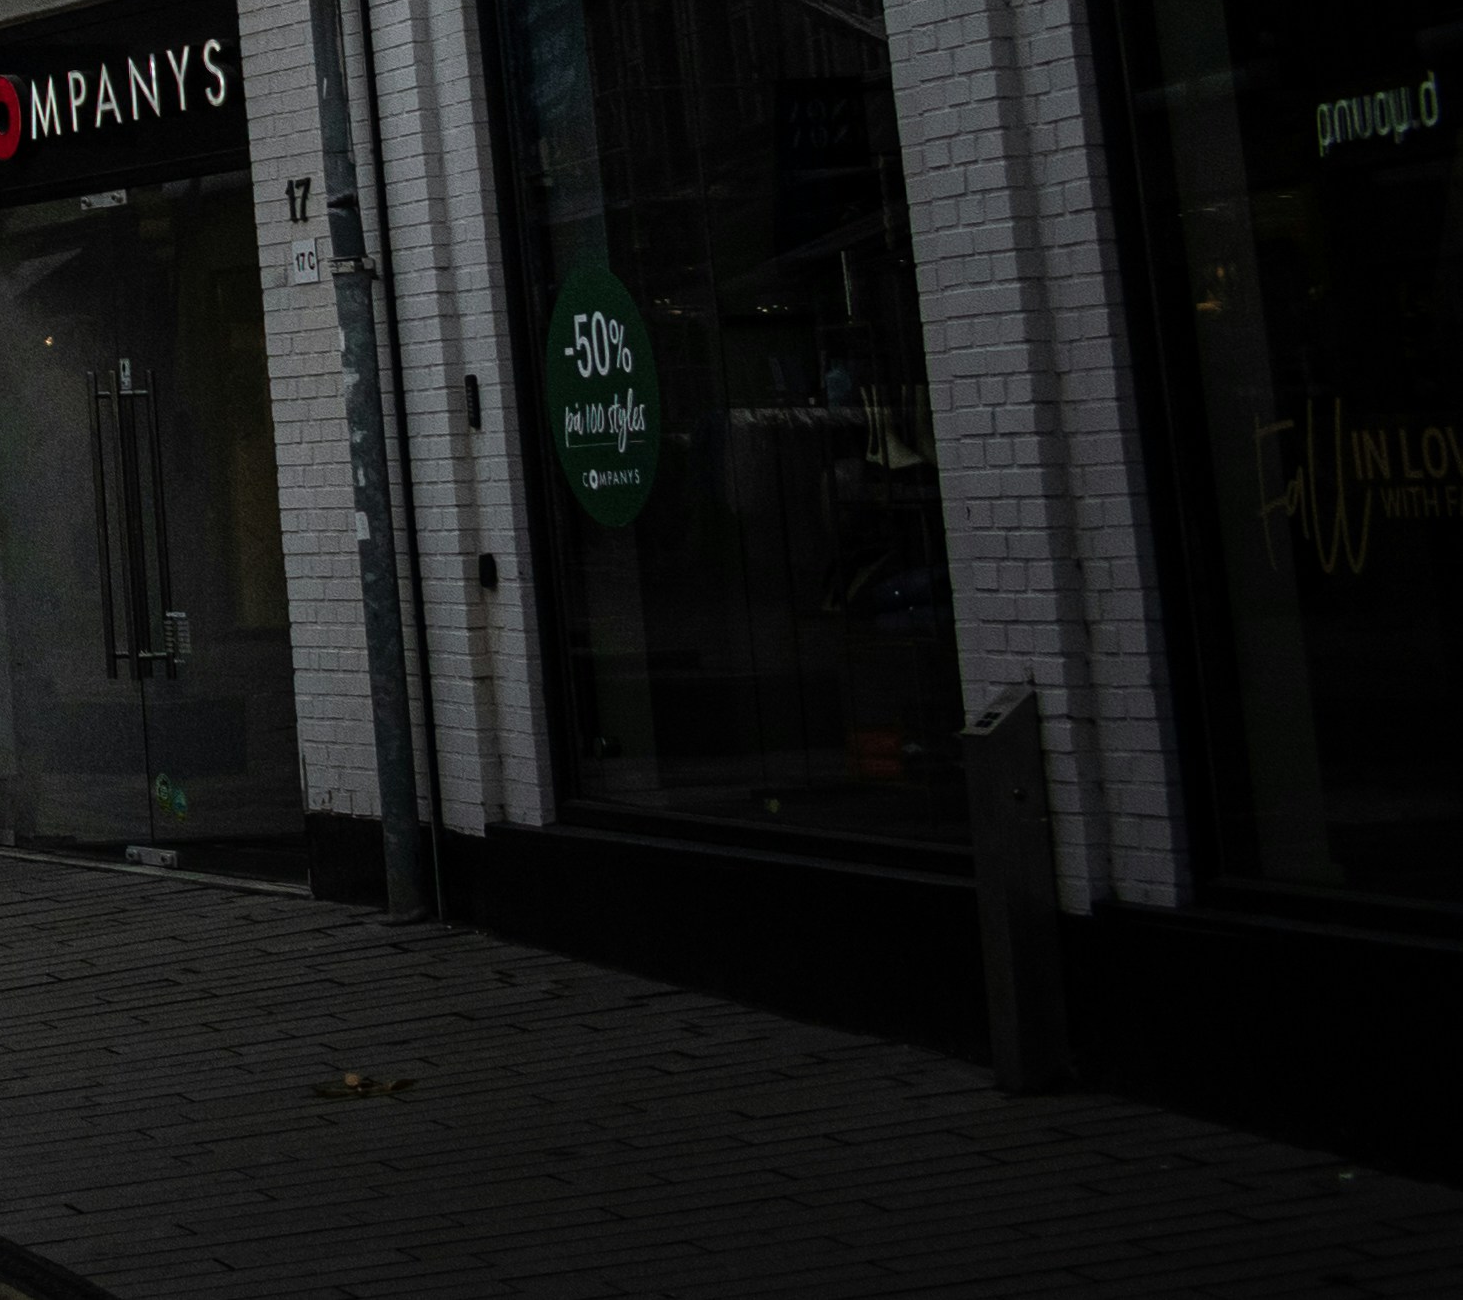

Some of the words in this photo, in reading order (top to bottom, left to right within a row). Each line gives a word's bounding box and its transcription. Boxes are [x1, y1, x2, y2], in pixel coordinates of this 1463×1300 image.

[285, 177, 311, 223] 17
[564, 310, 633, 379] -50%
[565, 401, 584, 449] på
[585, 402, 605, 435] 100
[607, 387, 647, 454] styles
[1350, 428, 1393, 481] IN
[582, 468, 641, 491] COMPANYS
[1380, 485, 1441, 519] WITH
[1444, 484, 1463, 519] F
